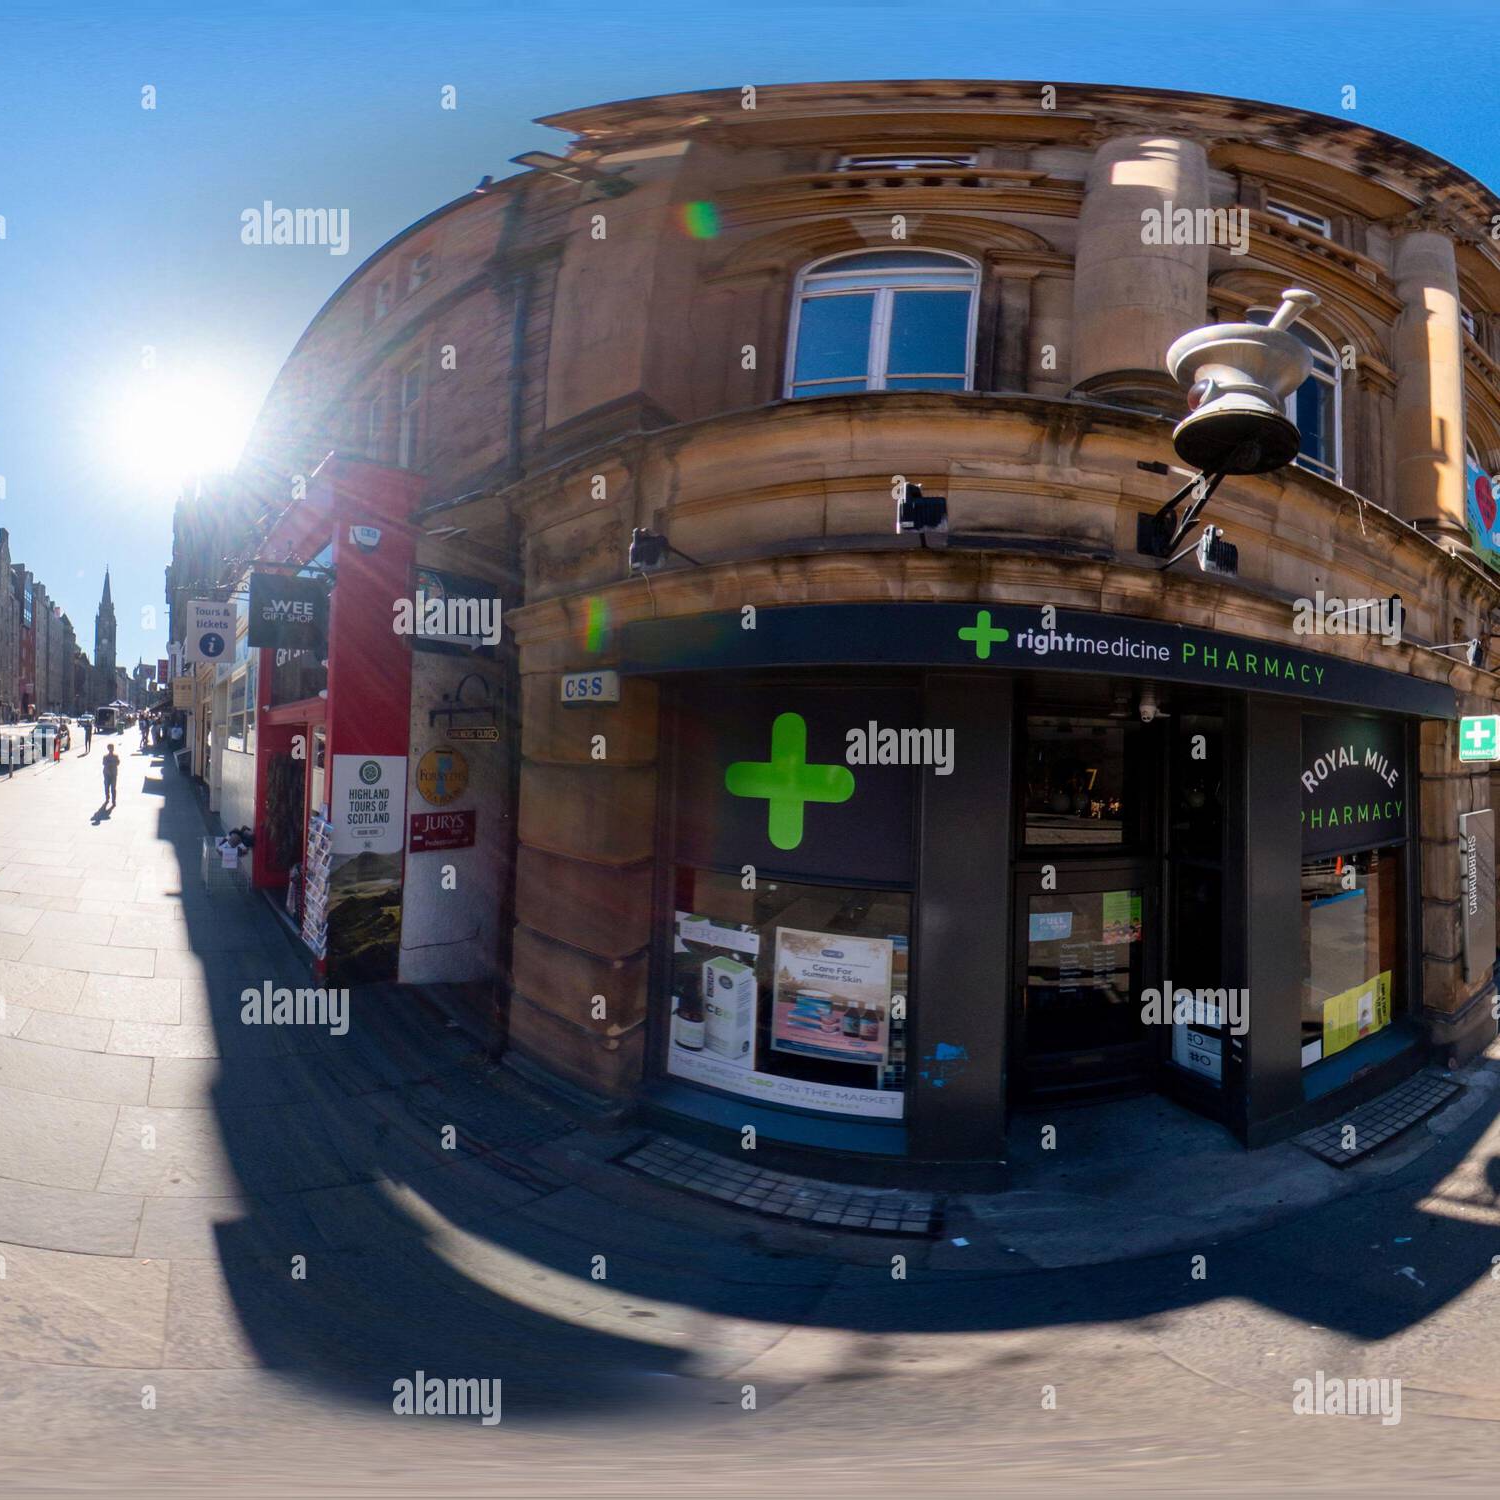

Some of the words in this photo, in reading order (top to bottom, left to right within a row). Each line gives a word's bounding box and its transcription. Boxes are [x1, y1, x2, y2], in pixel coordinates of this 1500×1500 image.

[195, 606, 221, 616] Tours
[271, 599, 314, 616] WEE
[262, 611, 285, 621] GIFT
[287, 613, 314, 623] SHOP
[196, 620, 229, 630] tickets
[1016, 627, 1171, 662] rightmedicine
[1182, 642, 1325, 686] PHARMACY
[1301, 744, 1359, 794] ROYAL
[1364, 746, 1400, 789] MILE
[1085, 768, 1098, 791] 7
[348, 788, 390, 800] HIGHLAND
[350, 800, 376, 812] TOURS
[378, 800, 388, 812] OF
[347, 812, 390, 825] SCOTLAND
[421, 814, 465, 833] JURYS
[1467, 834, 1477, 915] CARRUBBERS
[1039, 917, 1064, 925] PULL
[801, 969, 840, 981] Summer
[841, 975, 863, 984] Skin
[812, 963, 835, 973] Care
[836, 966, 853, 976] For
[746, 1075, 774, 1088] CBD
[776, 1081, 802, 1095] ON
[803, 1088, 832, 1100] THE
[834, 1091, 900, 1106] MARKET
